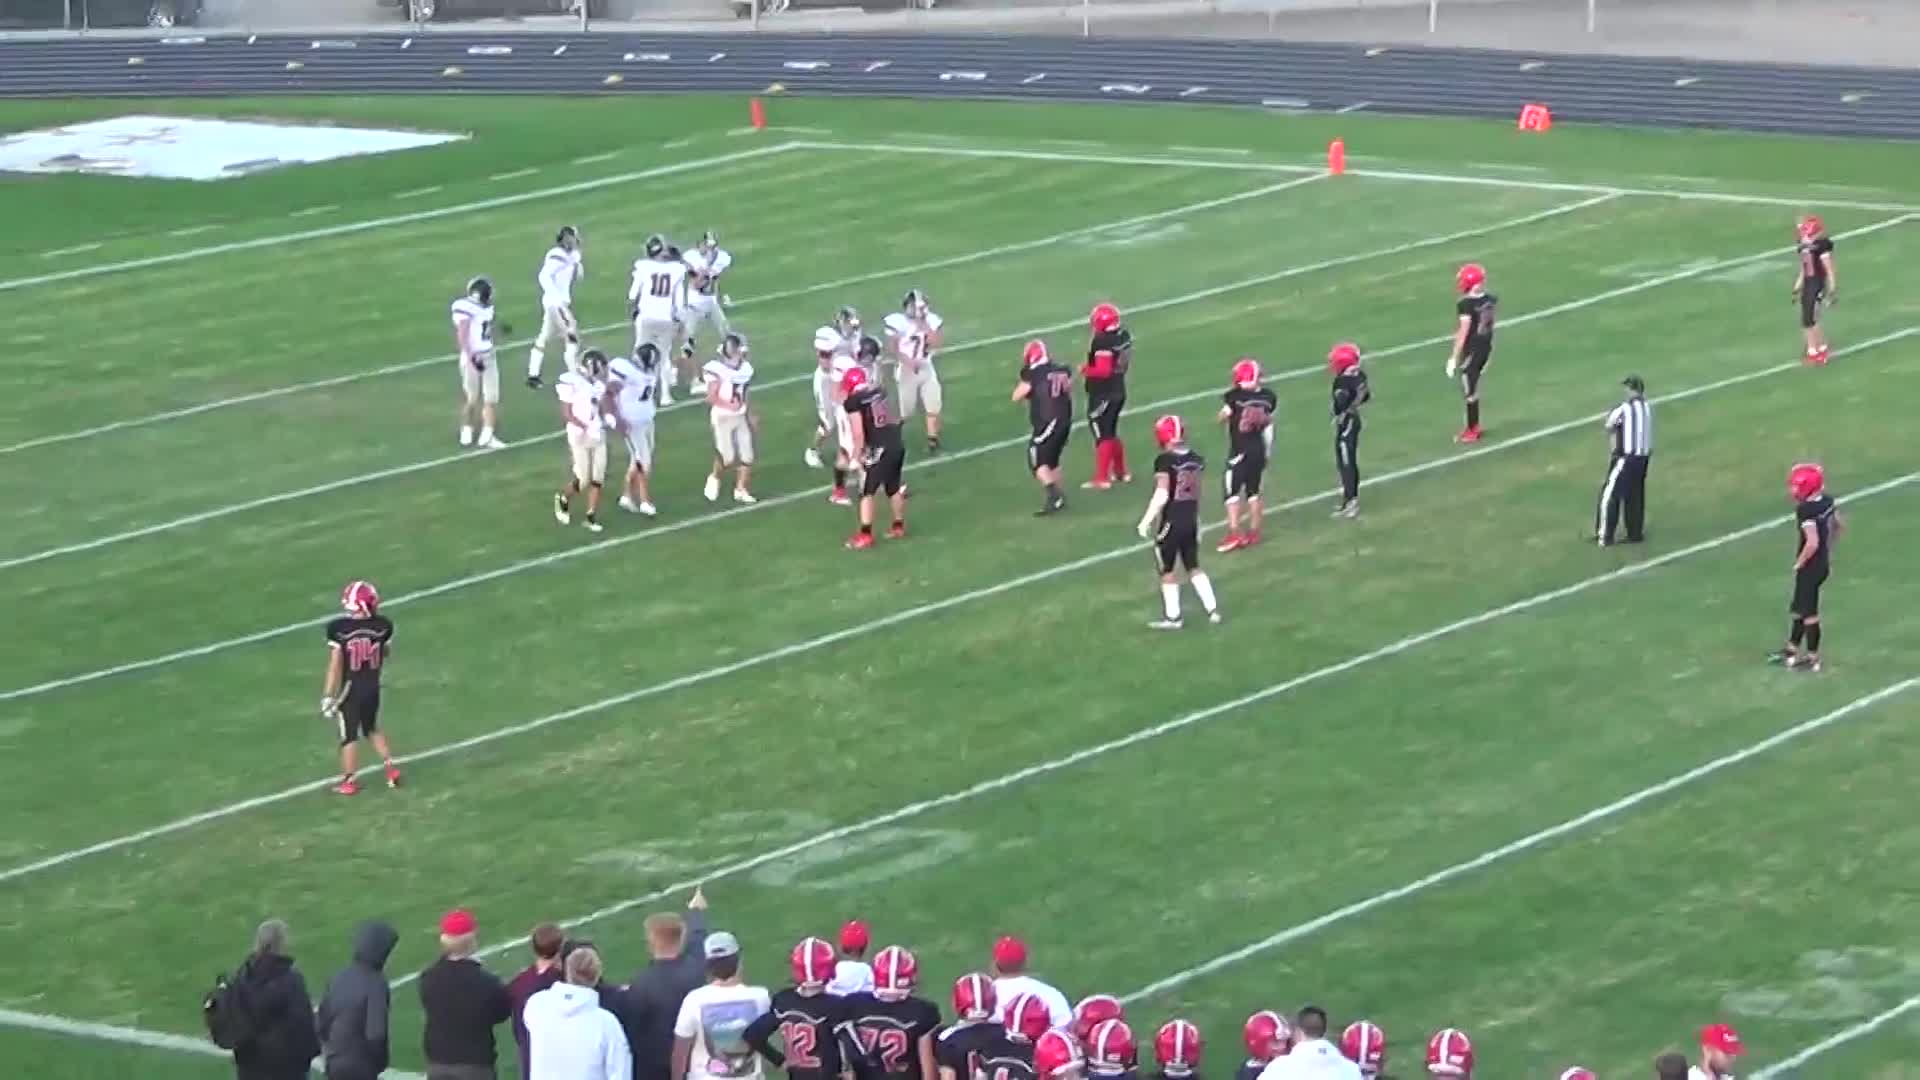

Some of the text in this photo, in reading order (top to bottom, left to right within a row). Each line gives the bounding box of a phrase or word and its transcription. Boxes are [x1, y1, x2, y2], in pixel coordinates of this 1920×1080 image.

[649, 273, 672, 297] 10
[347, 637, 381, 672] 14
[780, 1020, 822, 1069] 12
[859, 1025, 909, 1073] 72
